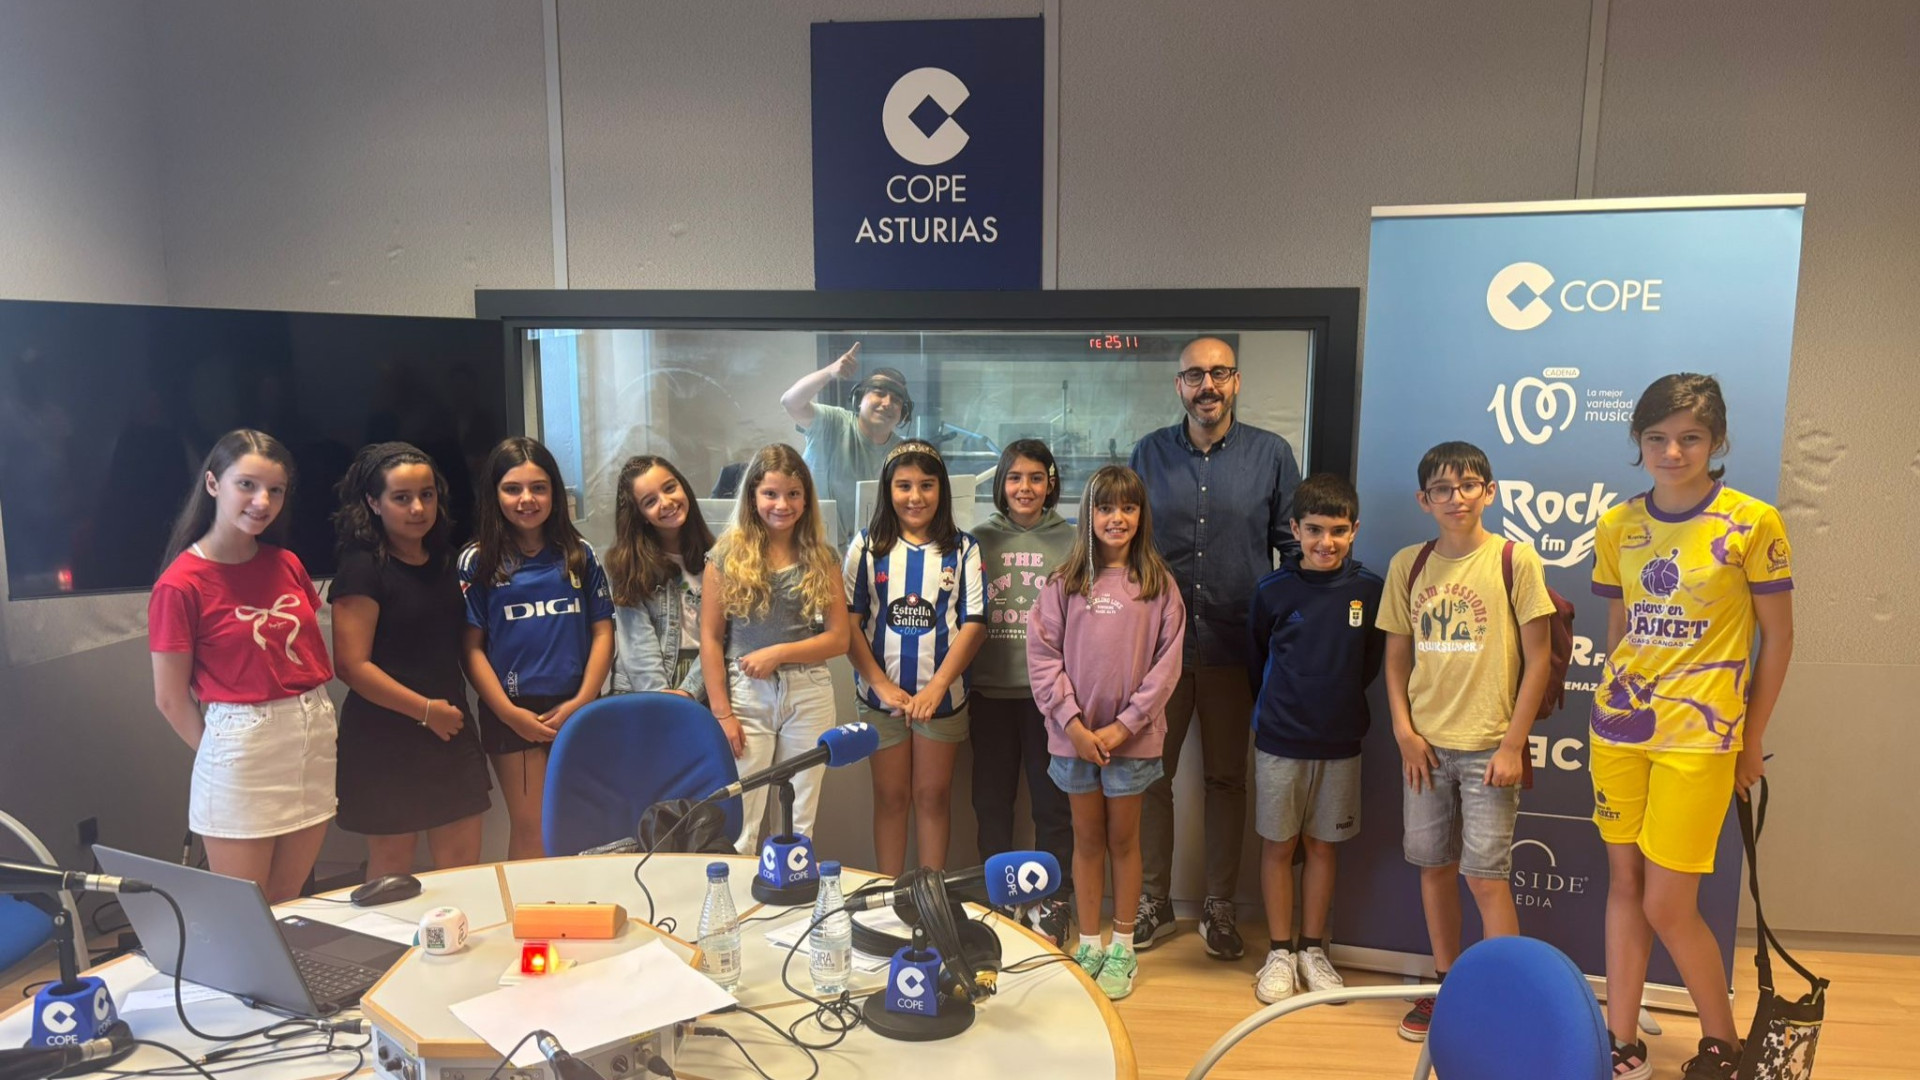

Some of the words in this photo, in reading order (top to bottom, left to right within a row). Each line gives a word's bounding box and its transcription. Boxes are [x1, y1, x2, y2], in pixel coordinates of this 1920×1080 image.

[886, 174, 967, 203] COPE
[855, 215, 998, 243] ASTURIAS
[1560, 279, 1663, 312] COPE
[1587, 389, 1597, 397] La
[1599, 390, 1623, 399] mejor
[1587, 399, 1633, 409] variedad
[1498, 480, 1618, 533] Rock
[1541, 533, 1566, 552] fm
[1001, 552, 1044, 567] THE
[987, 572, 1012, 600] EW
[1020, 571, 1047, 589] YO
[504, 598, 581, 621] DIGI
[892, 604, 931, 617] Estrella
[893, 614, 929, 627] Galicia
[1563, 681, 1599, 692] EMAZ
[789, 870, 808, 882] COPE
[1005, 865, 1018, 897] COPE
[1515, 870, 1584, 894] SIDE
[1516, 894, 1552, 909] EDIA
[897, 997, 924, 1011] COPE
[46, 1034, 78, 1046] COPE
